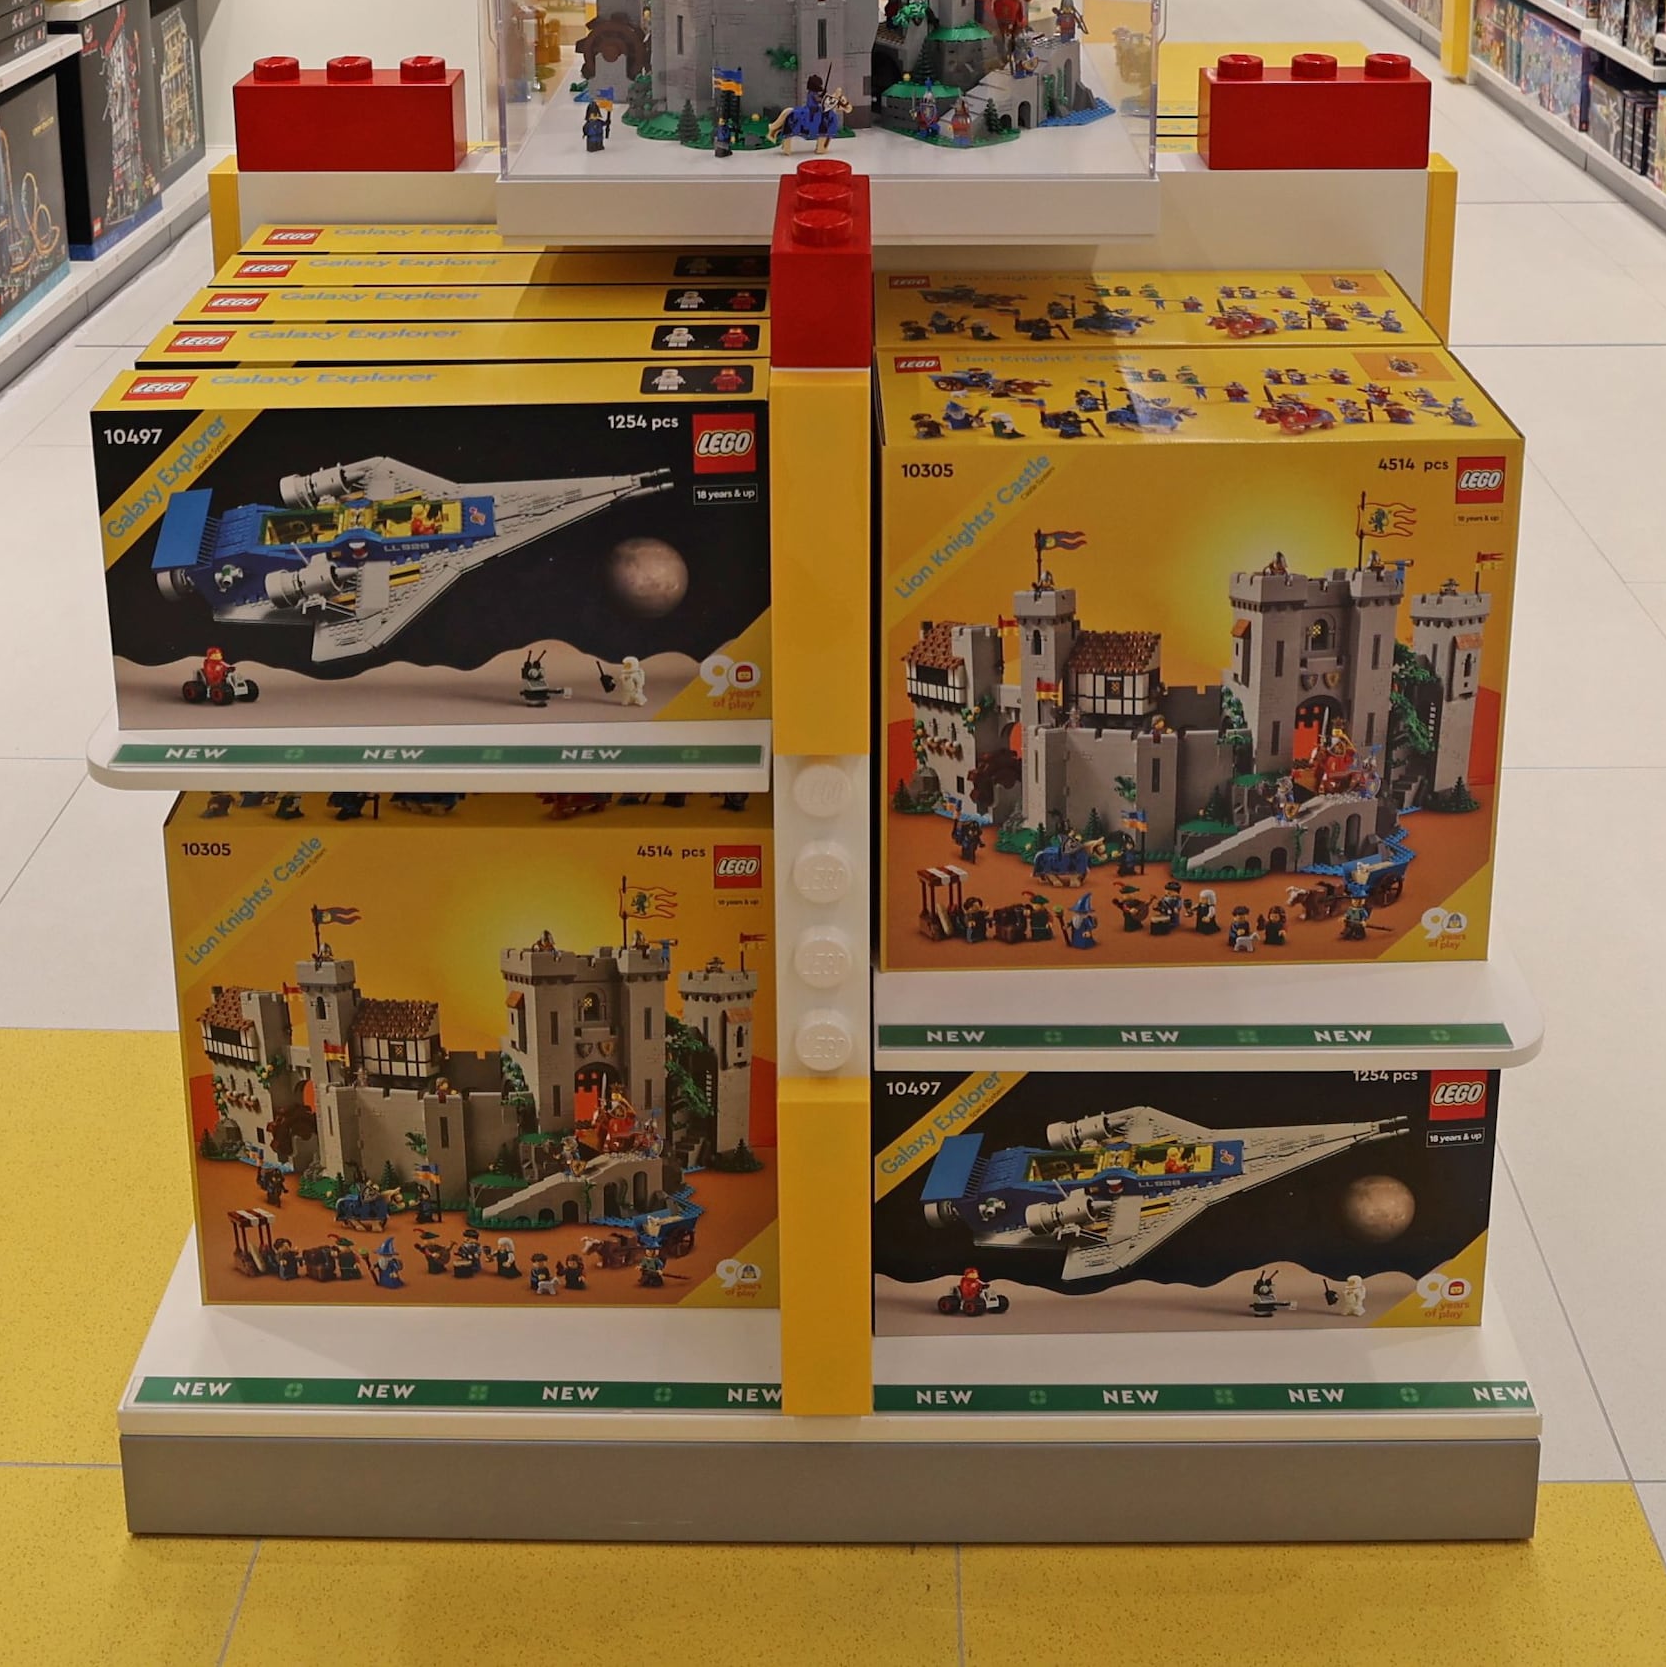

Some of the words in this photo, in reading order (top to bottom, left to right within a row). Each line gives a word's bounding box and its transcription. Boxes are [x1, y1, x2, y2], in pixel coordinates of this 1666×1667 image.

[240, 262, 290, 277] LEGO
[398, 257, 501, 270] Explorer
[207, 294, 262, 310] LEGO
[374, 289, 481, 303] Explorer
[173, 333, 229, 349] LEGO
[348, 327, 463, 343] Explorer
[131, 382, 188, 394] LEGO
[607, 414, 647, 429] 1254
[651, 416, 679, 431] pcs
[103, 428, 163, 445] 10497
[696, 431, 752, 455] LEGO
[901, 463, 954, 478] 10305
[1378, 457, 1416, 471] 4514
[1423, 458, 1449, 472] pcs
[106, 484, 164, 539] Galaxy
[156, 414, 228, 487] Explorer
[1457, 472, 1502, 491] LEGO
[696, 490, 707, 499] 18
[708, 490, 732, 501] years
[743, 489, 756, 500] up
[894, 561, 935, 599] Lion
[994, 452, 1052, 506] Castle
[165, 746, 228, 761] NEW
[362, 746, 424, 761] NEW
[560, 746, 622, 761] NEW
[181, 842, 232, 856] 10305
[636, 845, 673, 859] 4514
[681, 846, 706, 860] pcs
[715, 857, 760, 876] LEGO
[184, 932, 222, 966] Lion
[272, 835, 323, 882] Castle
[926, 1030, 985, 1044] NEW
[1120, 1030, 1180, 1044] NEW
[1313, 1029, 1373, 1043] NEW
[1353, 1070, 1390, 1082] 1254
[1392, 1070, 1419, 1084] pcs
[884, 1081, 941, 1096] 10497
[1432, 1083, 1485, 1105] LEGO
[879, 1130, 936, 1175] Galaxy
[934, 1071, 1001, 1133] Explorer
[173, 1381, 232, 1397] NEW
[356, 1383, 415, 1399] NEW
[541, 1385, 599, 1401] NEW
[726, 1387, 781, 1403] NEW
[915, 1389, 973, 1405] NEW
[1101, 1389, 1159, 1404] NEW
[1287, 1388, 1345, 1404] NEW
[1471, 1386, 1530, 1403] NEW
